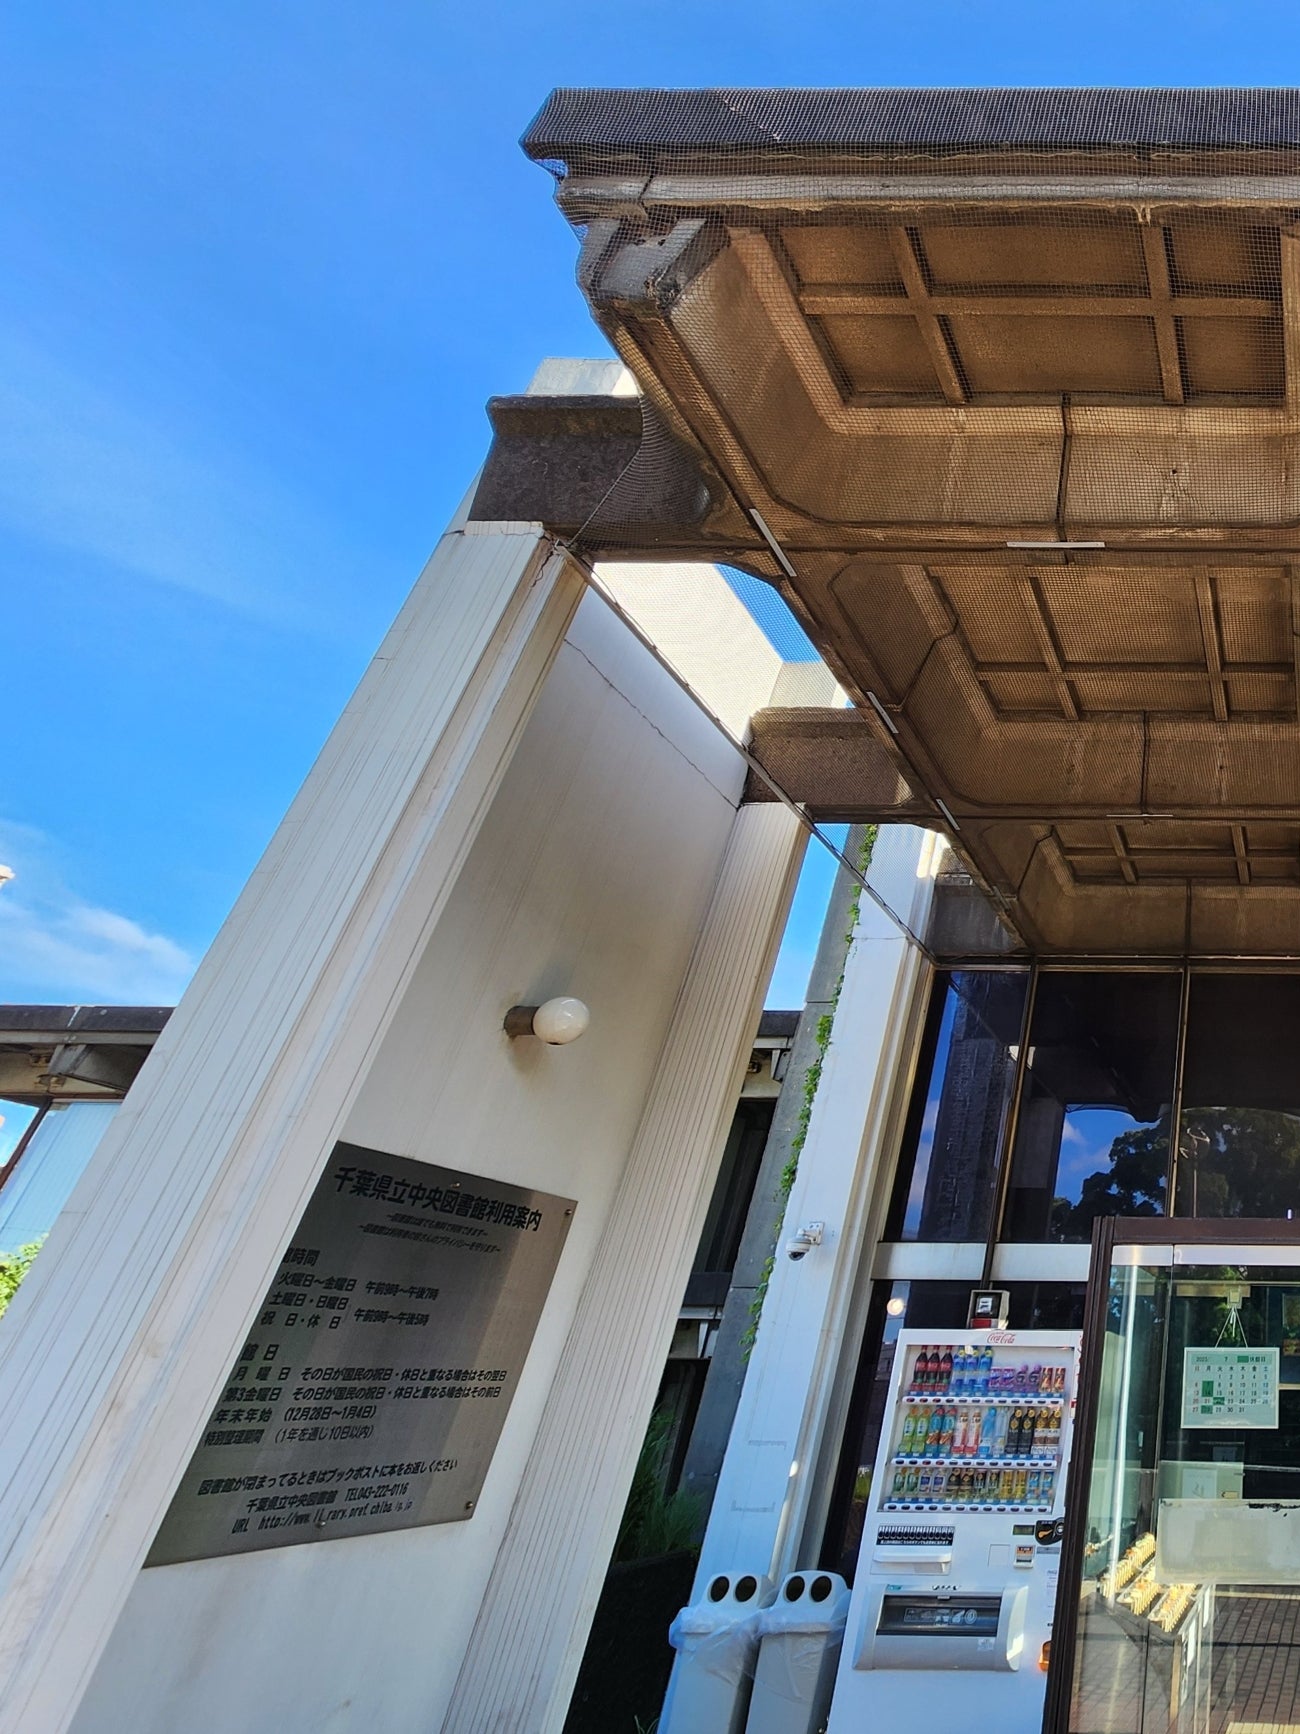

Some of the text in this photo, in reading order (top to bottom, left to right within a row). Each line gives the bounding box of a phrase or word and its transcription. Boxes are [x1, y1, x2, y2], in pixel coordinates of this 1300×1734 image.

[334, 1167, 543, 1232] 千葉県立中央図書館利用案内
[213, 1407, 272, 1424] 年末年始
[246, 1489, 339, 1514] 千葉県立中央図書館
[231, 1517, 250, 1534] URL
